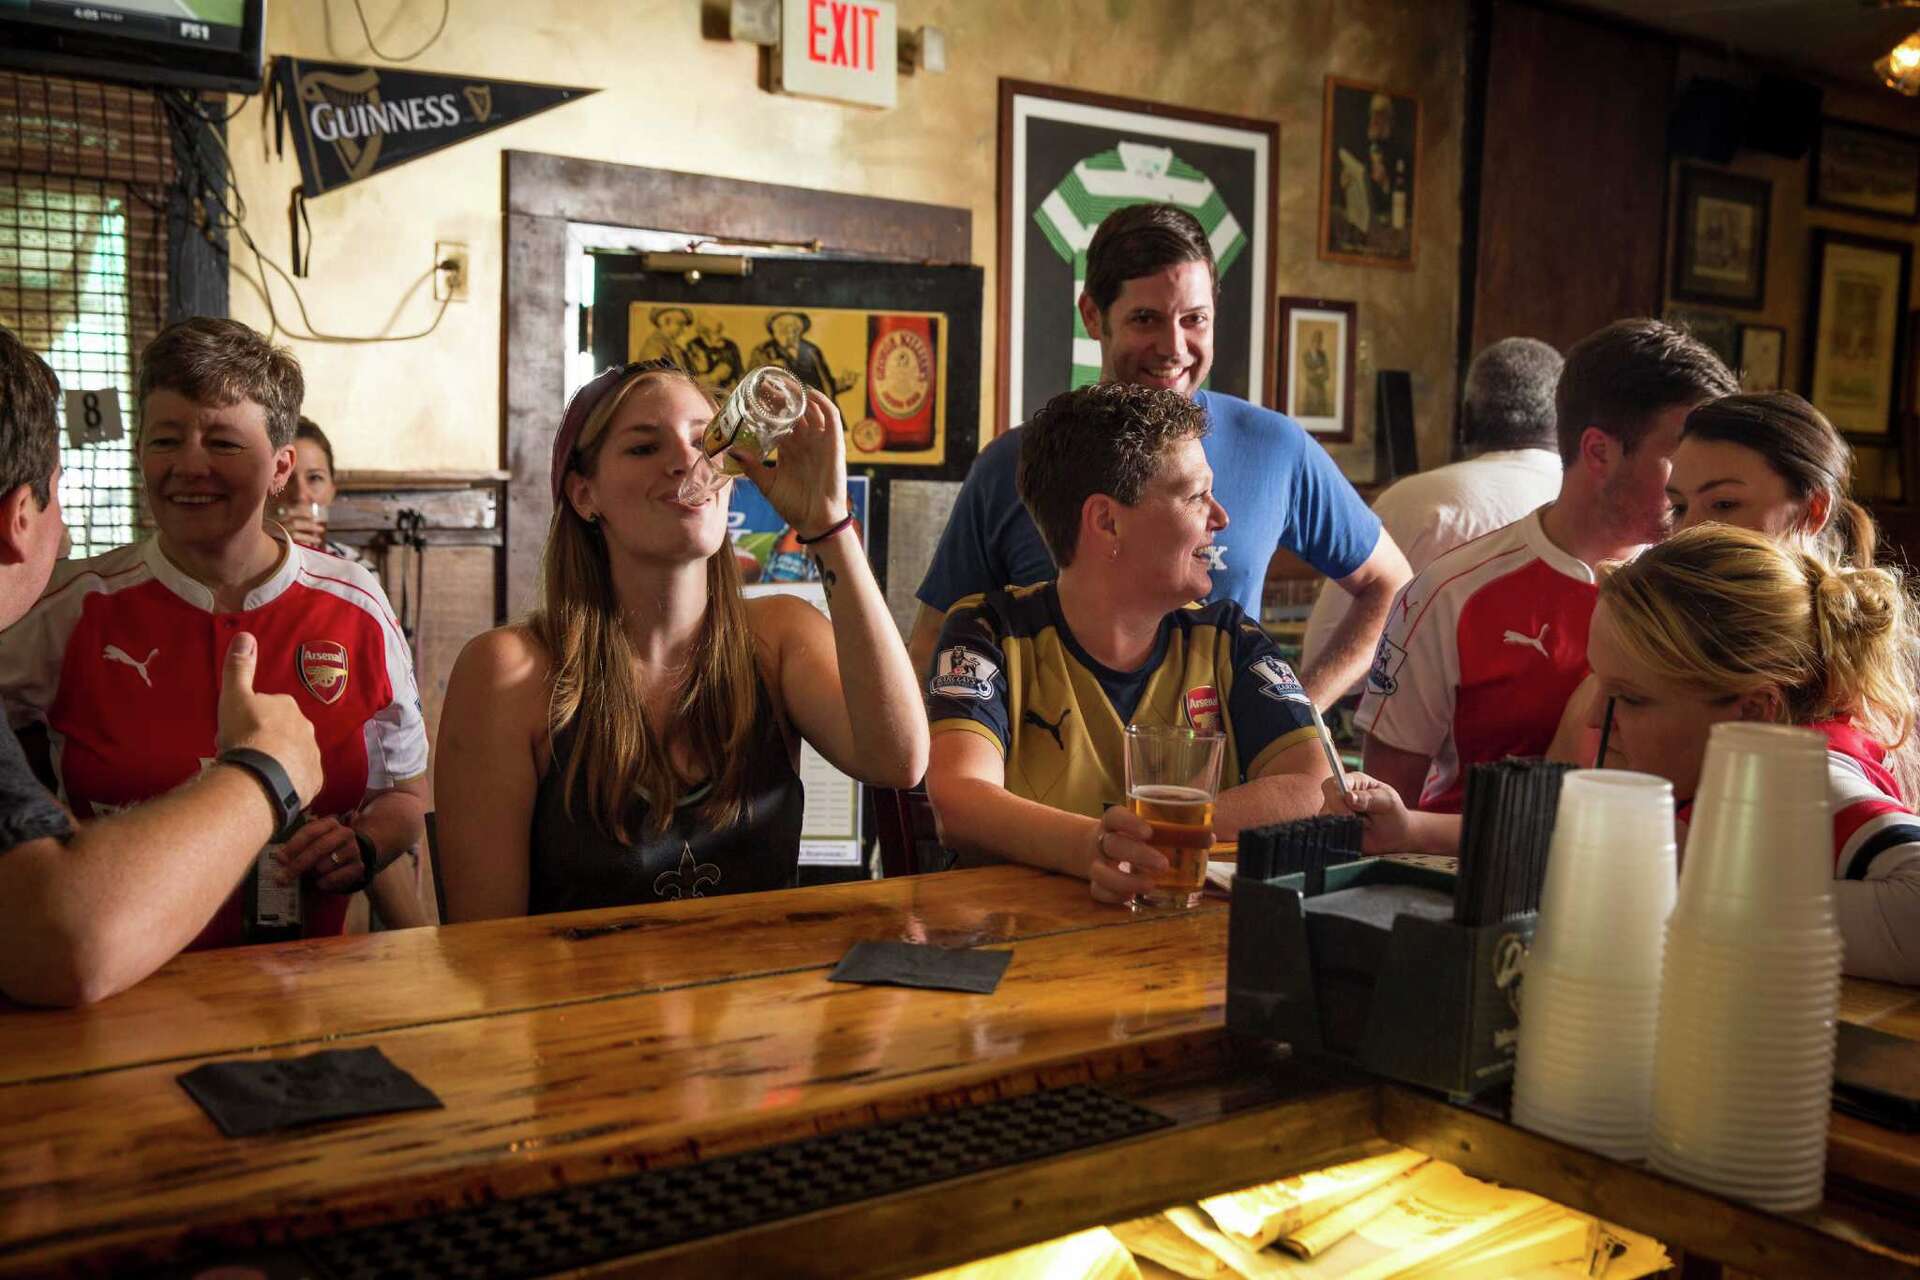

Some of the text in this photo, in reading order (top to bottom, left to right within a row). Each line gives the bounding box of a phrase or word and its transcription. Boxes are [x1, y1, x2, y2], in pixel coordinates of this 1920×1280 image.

[808, 0, 878, 71] EXIT
[310, 94, 460, 142] GUINNESS
[83, 392, 102, 429] 8
[304, 649, 343, 663] Arsenal
